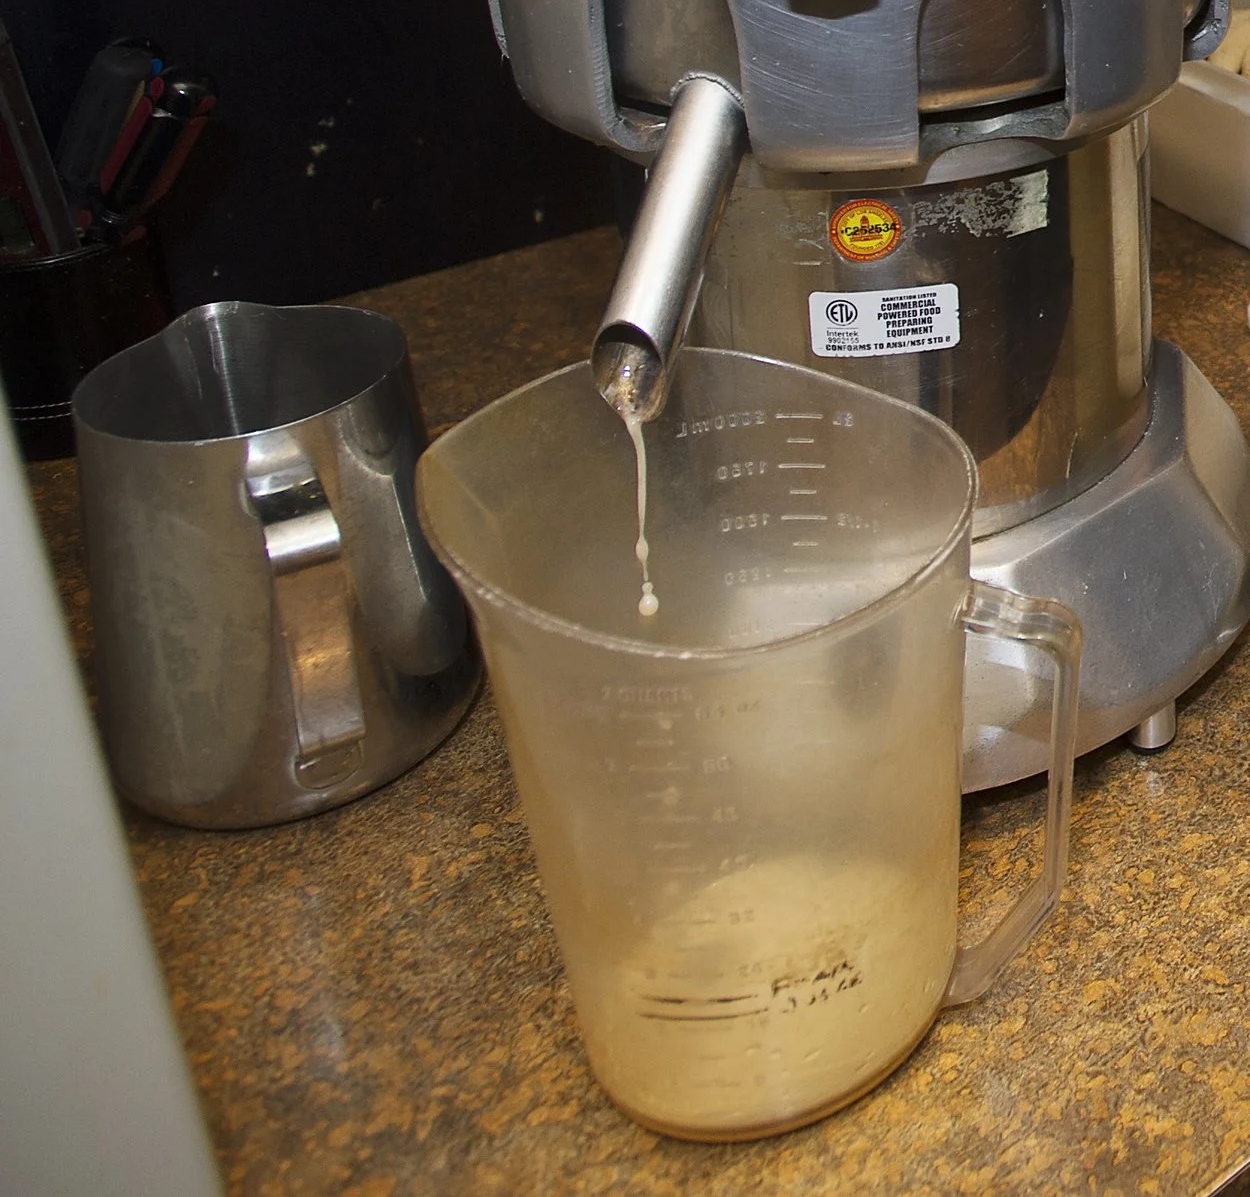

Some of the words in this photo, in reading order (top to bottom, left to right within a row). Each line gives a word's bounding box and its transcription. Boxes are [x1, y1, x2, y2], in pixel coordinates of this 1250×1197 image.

[882, 294, 917, 302] SANITATION
[880, 299, 937, 312] COMMERCIAL
[877, 310, 918, 321] POWERED
[919, 306, 941, 317] FOOD
[886, 316, 933, 329] PREPARING
[826, 329, 860, 337] Intertek
[887, 325, 934, 338] EQUIPMENT
[825, 343, 872, 352] CONFORMS
[886, 338, 926, 349] ANSI/NSF
[927, 336, 944, 345] STD
